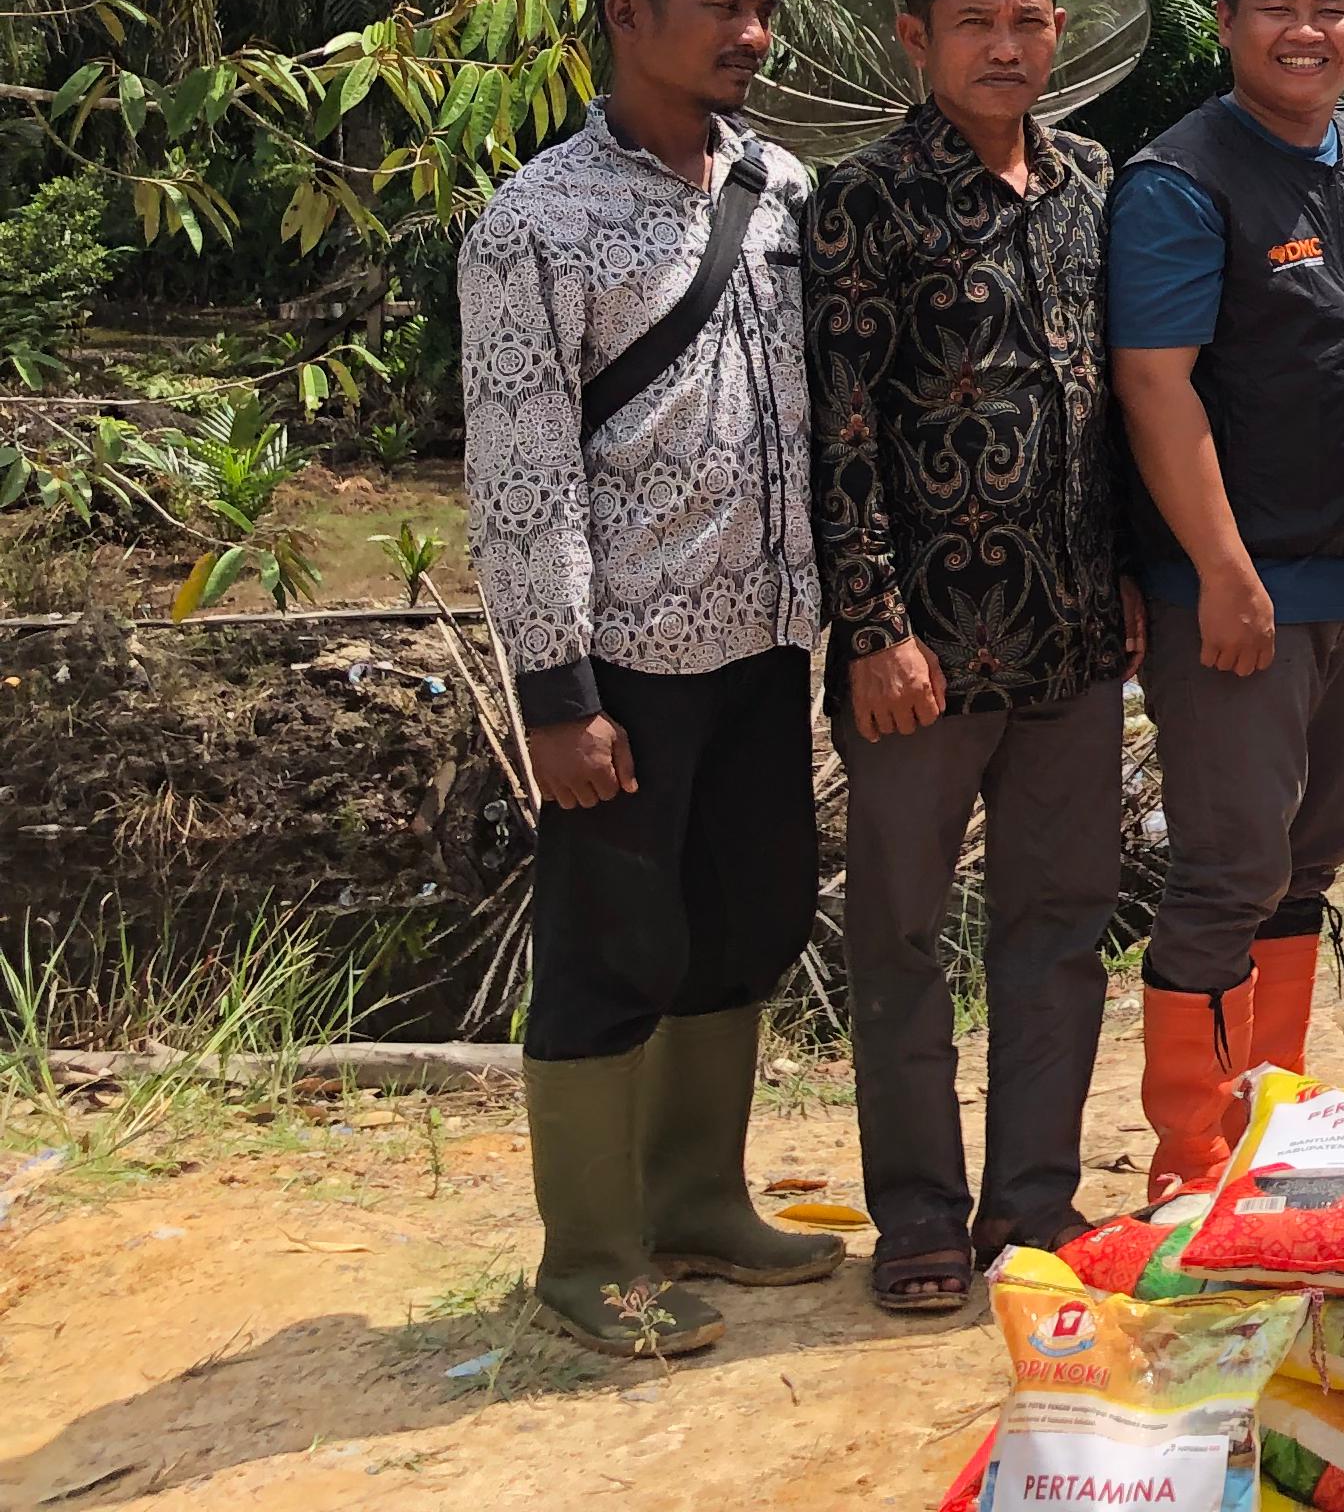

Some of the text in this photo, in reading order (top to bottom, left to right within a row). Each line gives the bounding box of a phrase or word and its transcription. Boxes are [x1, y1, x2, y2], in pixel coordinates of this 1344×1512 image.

[1284, 237, 1324, 261] DMC
[1016, 1359, 1111, 1389] OPI KOKI
[1023, 1474, 1177, 1505] PERTAMINA
